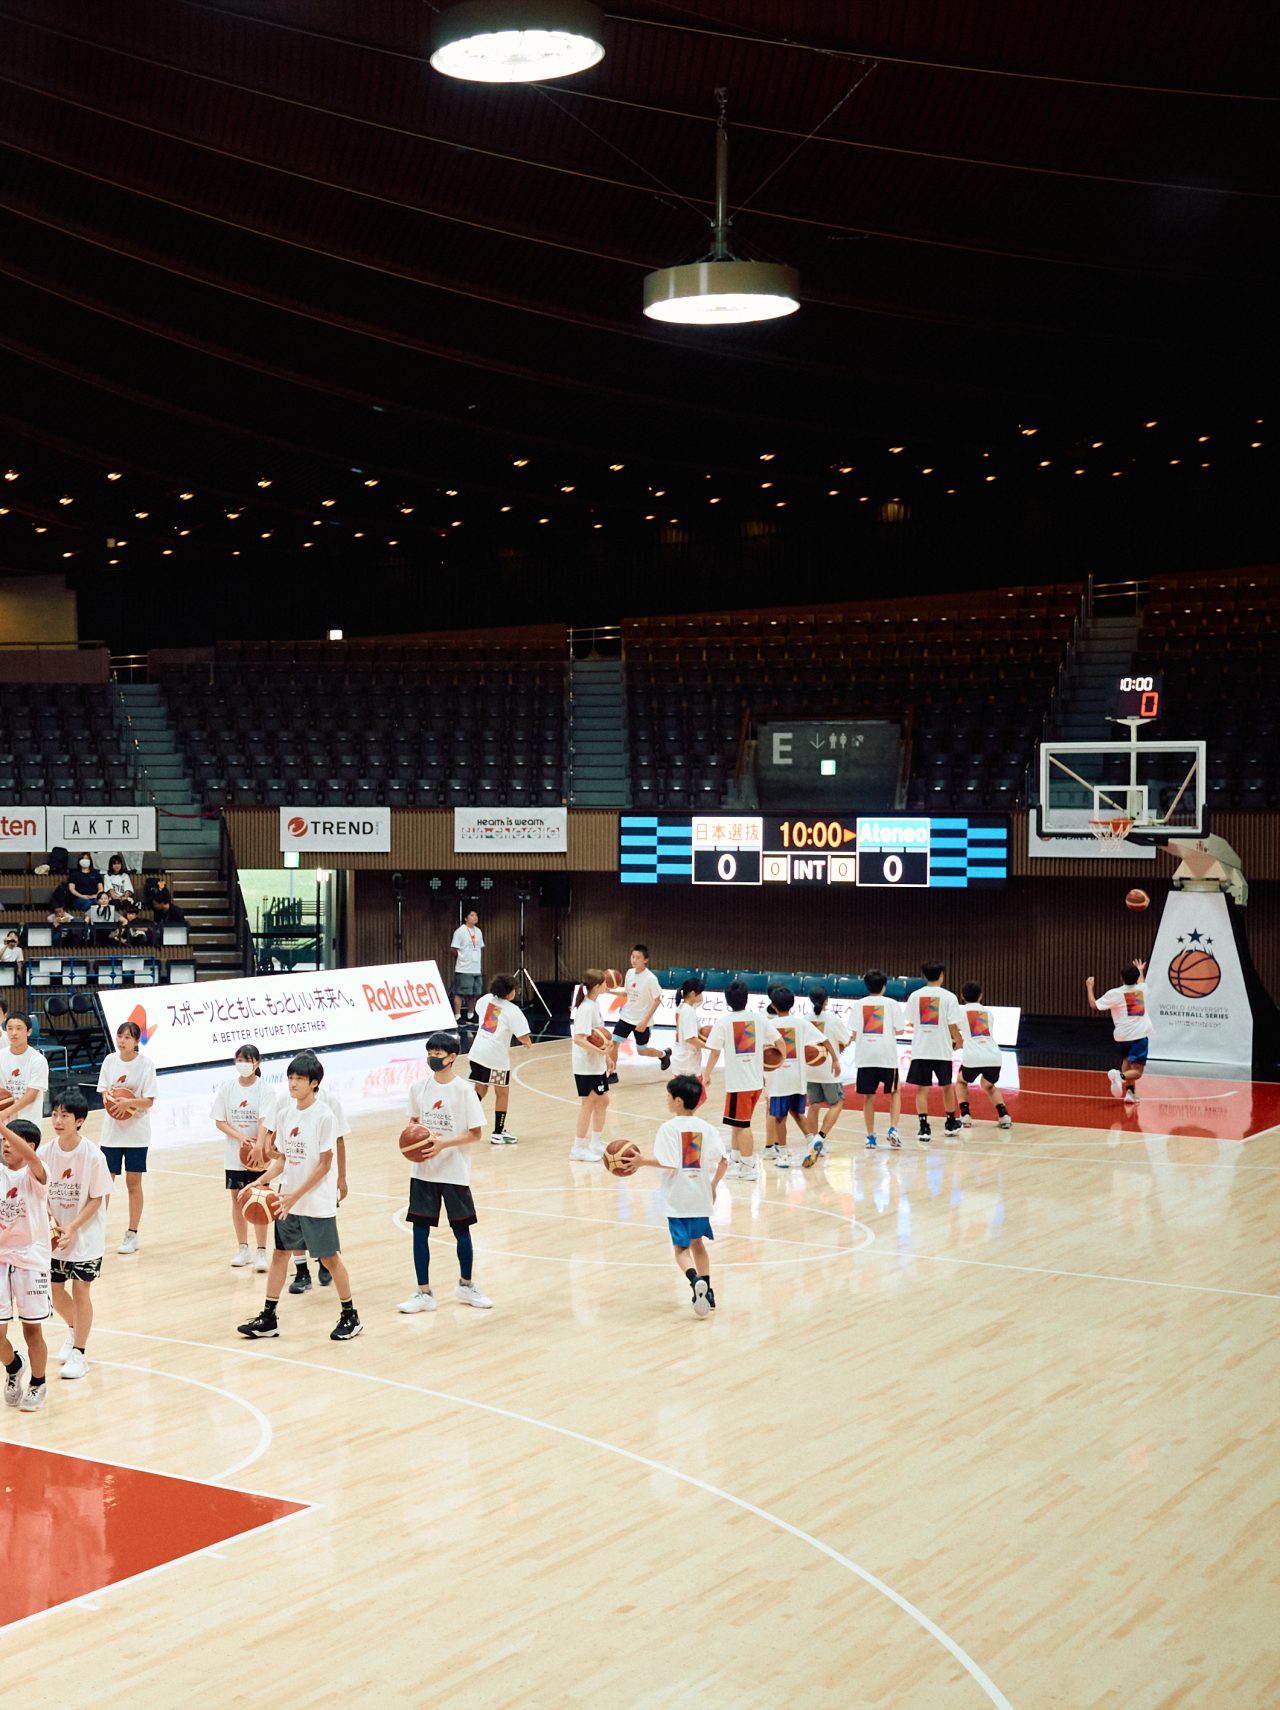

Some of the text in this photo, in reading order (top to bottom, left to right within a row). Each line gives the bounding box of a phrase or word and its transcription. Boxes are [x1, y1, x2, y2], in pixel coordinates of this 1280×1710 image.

[1120, 677, 1153, 691] 10:00
[1140, 691, 1158, 717] 0
[772, 732, 793, 764] E
[311, 821, 375, 836] TREND
[696, 823, 760, 841] 日本選抜
[780, 821, 842, 848] 10:00
[858, 823, 928, 843] Ateneo
[717, 853, 736, 881] 0
[771, 862, 779, 876] 0
[793, 860, 825, 879] INT
[839, 862, 848, 876] 0
[883, 855, 903, 882] 0
[363, 979, 441, 1012] Rakuten
[167, 986, 356, 1028] スポーツとともに、もっといい未来へ。
[1160, 1010, 1203, 1018] BASKETBALL
[213, 1020, 327, 1044] A BETTER FUTURE TOGETHER
